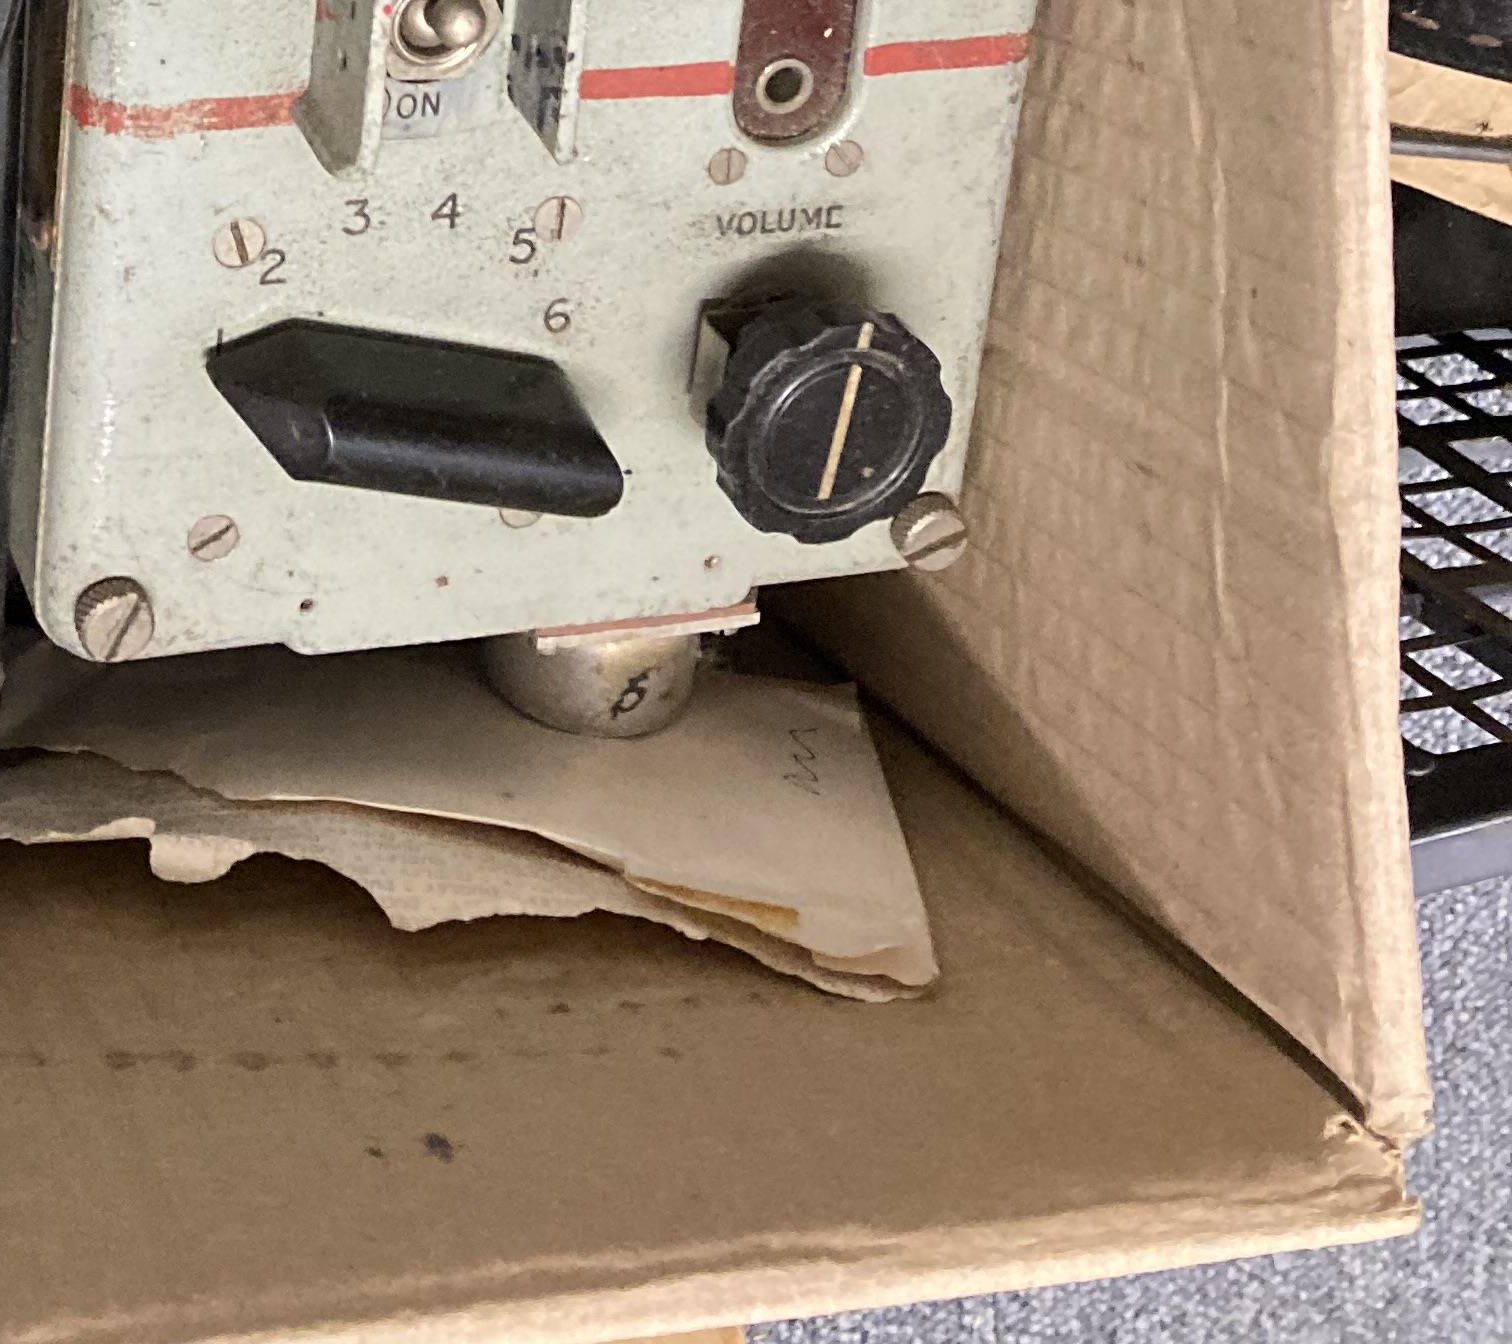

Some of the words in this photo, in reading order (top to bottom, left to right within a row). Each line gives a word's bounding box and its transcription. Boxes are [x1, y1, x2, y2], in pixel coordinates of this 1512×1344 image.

[396, 91, 442, 120] ON
[342, 198, 371, 236] 3
[430, 193, 461, 230] 4
[716, 205, 844, 237] VOLUME
[508, 228, 537, 264] 5
[259, 248, 287, 285] 2
[543, 297, 572, 334] 6
